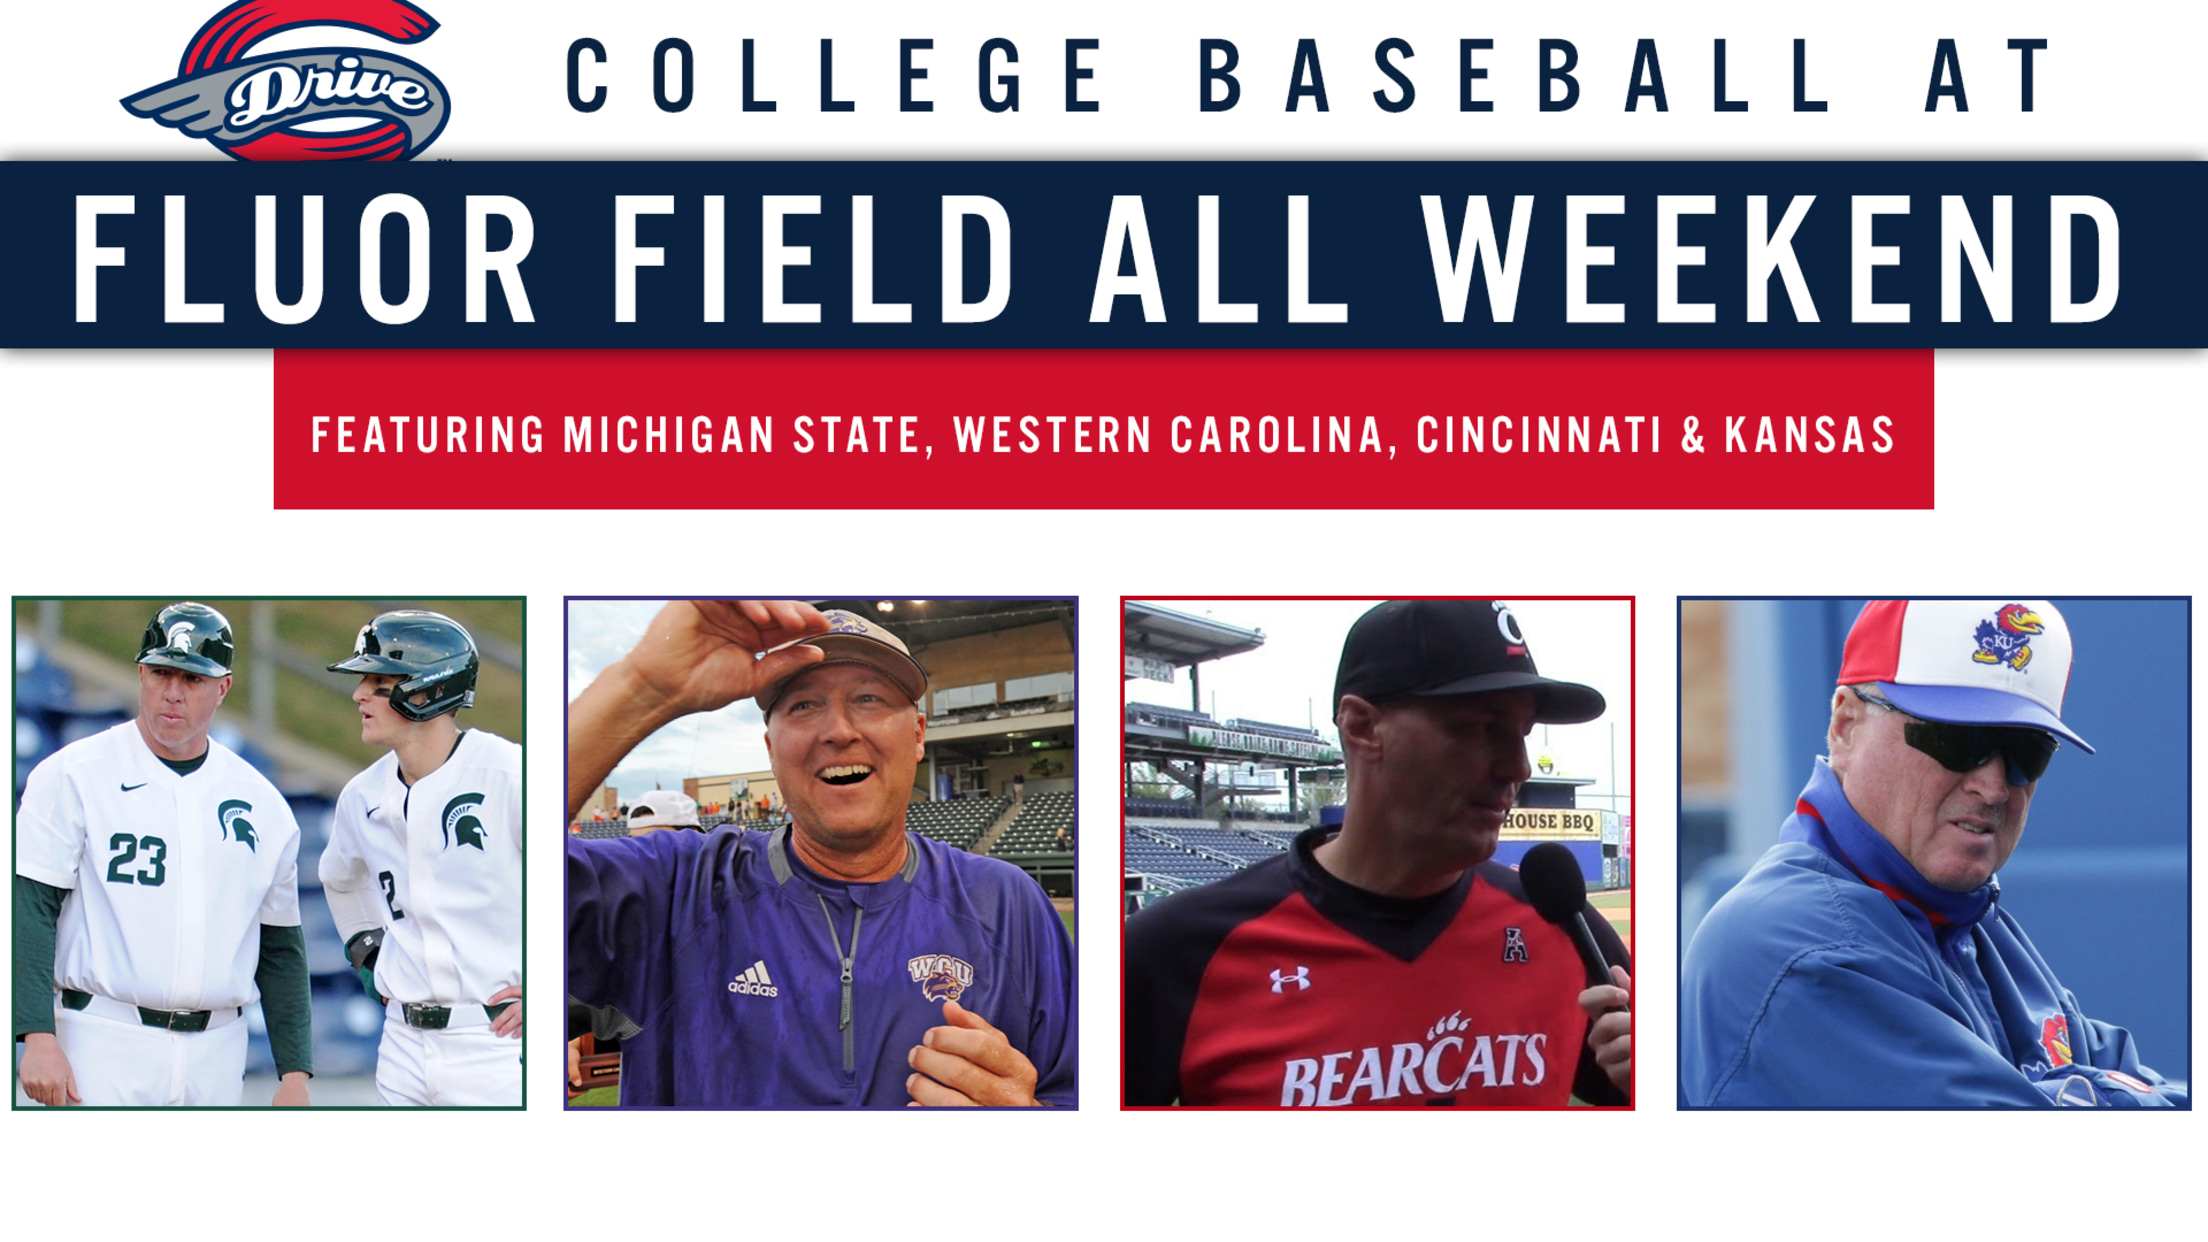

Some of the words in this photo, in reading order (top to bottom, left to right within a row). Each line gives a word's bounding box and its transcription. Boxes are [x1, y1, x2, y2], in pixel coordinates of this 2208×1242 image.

[1994, 634, 2014, 650] KU
[1212, 730, 1241, 749] PLEASE
[1562, 814, 1594, 832] BBQ
[106, 832, 167, 887] 23
[378, 870, 405, 921] 2
[908, 954, 973, 987] WCU
[728, 981, 778, 998] adidas
[1279, 1033, 1548, 1107] BEARCATS
